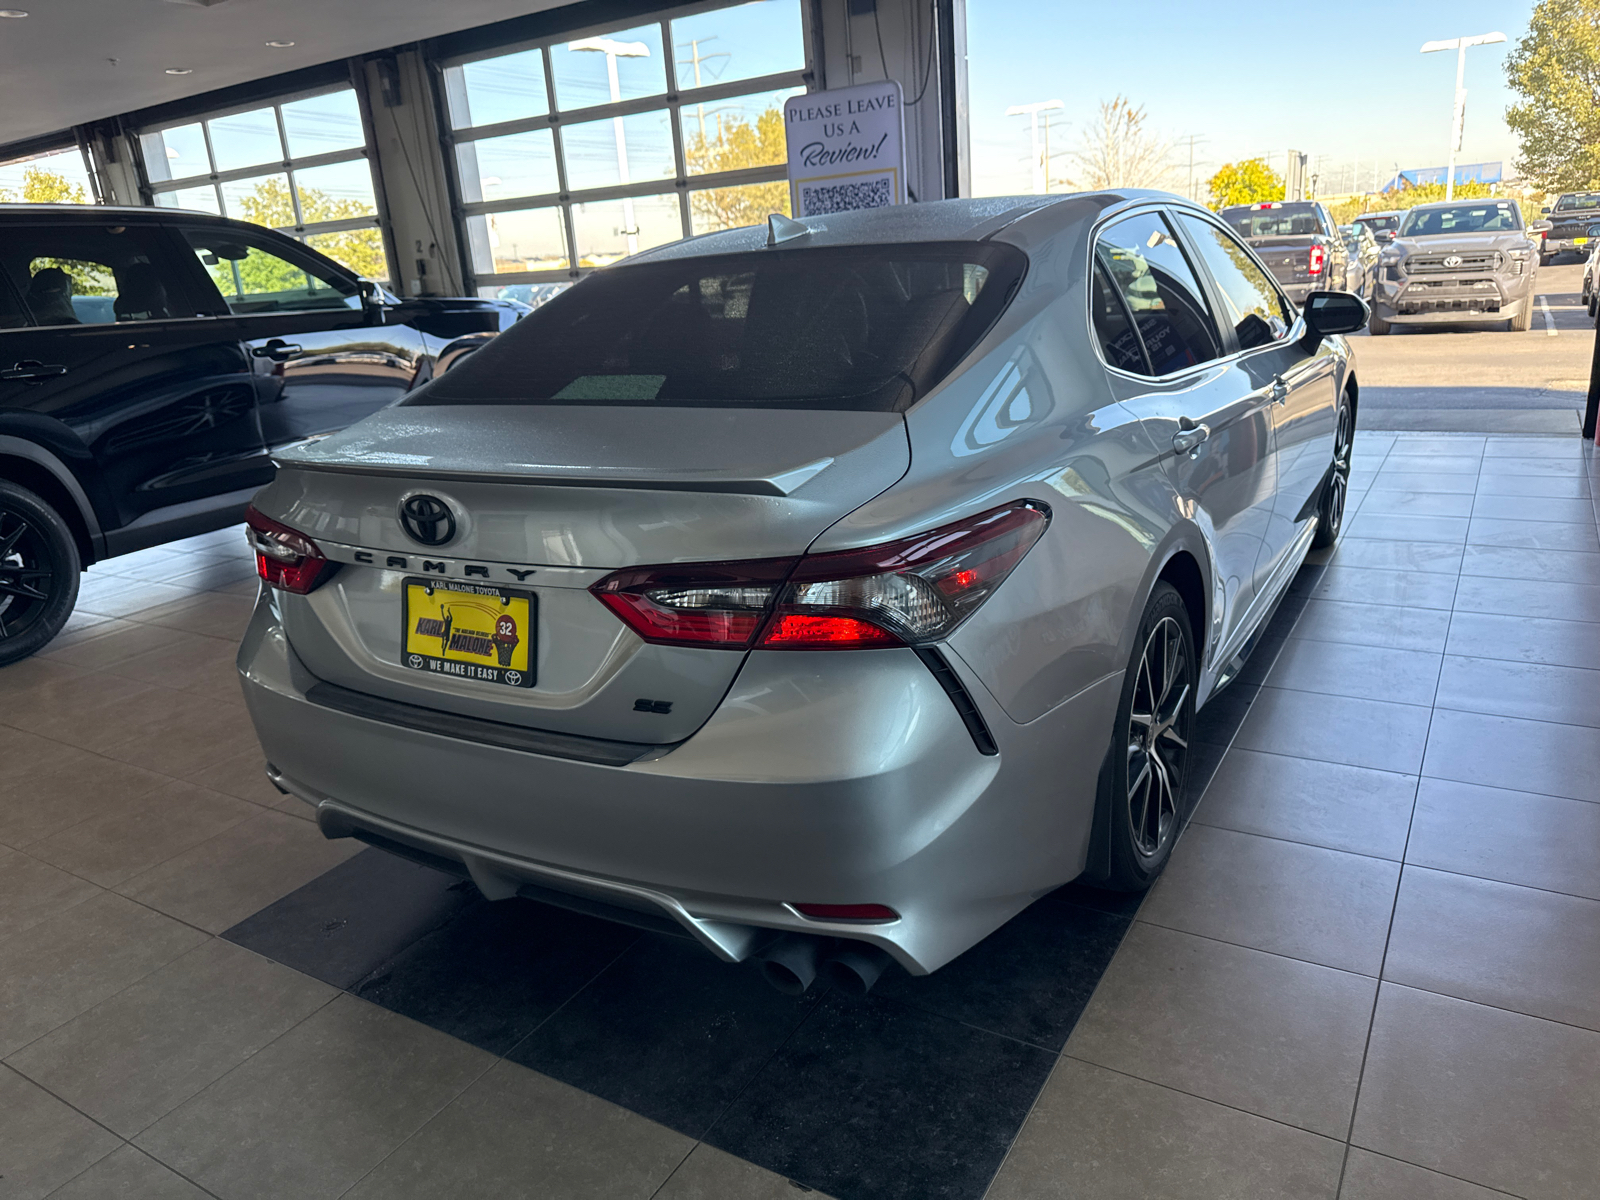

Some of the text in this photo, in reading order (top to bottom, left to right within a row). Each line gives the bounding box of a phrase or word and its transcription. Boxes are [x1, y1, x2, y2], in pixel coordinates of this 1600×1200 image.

[789, 94, 895, 122] PLEASE LEAVE
[849, 120, 860, 135] A
[800, 132, 888, 168] Review!
[354, 551, 537, 581] CAMRY
[431, 581, 500, 596] KARL MALONE TOYOTA
[415, 617, 444, 638] KARL
[499, 621, 513, 636] 32
[448, 633, 493, 657] MALONE
[430, 659, 498, 681] WE MAKE IT EASY
